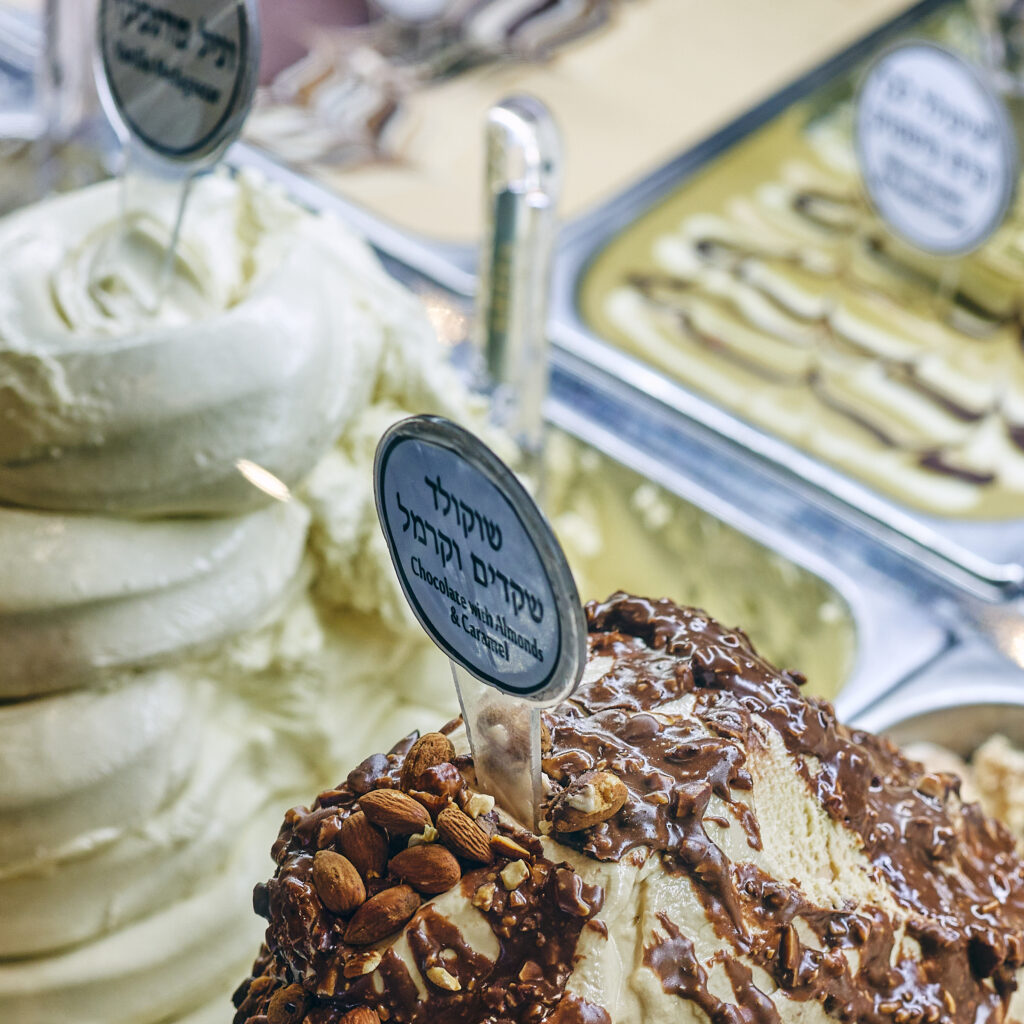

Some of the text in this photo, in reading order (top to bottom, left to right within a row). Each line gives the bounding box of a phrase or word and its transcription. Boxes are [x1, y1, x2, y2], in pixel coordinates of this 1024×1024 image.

[396, 492, 544, 624] שקדים וקרמל
[425, 475, 503, 551] שוקולד
[410, 556, 545, 662] Chocolate with Almonds
[450, 606, 510, 662] & Caramel
